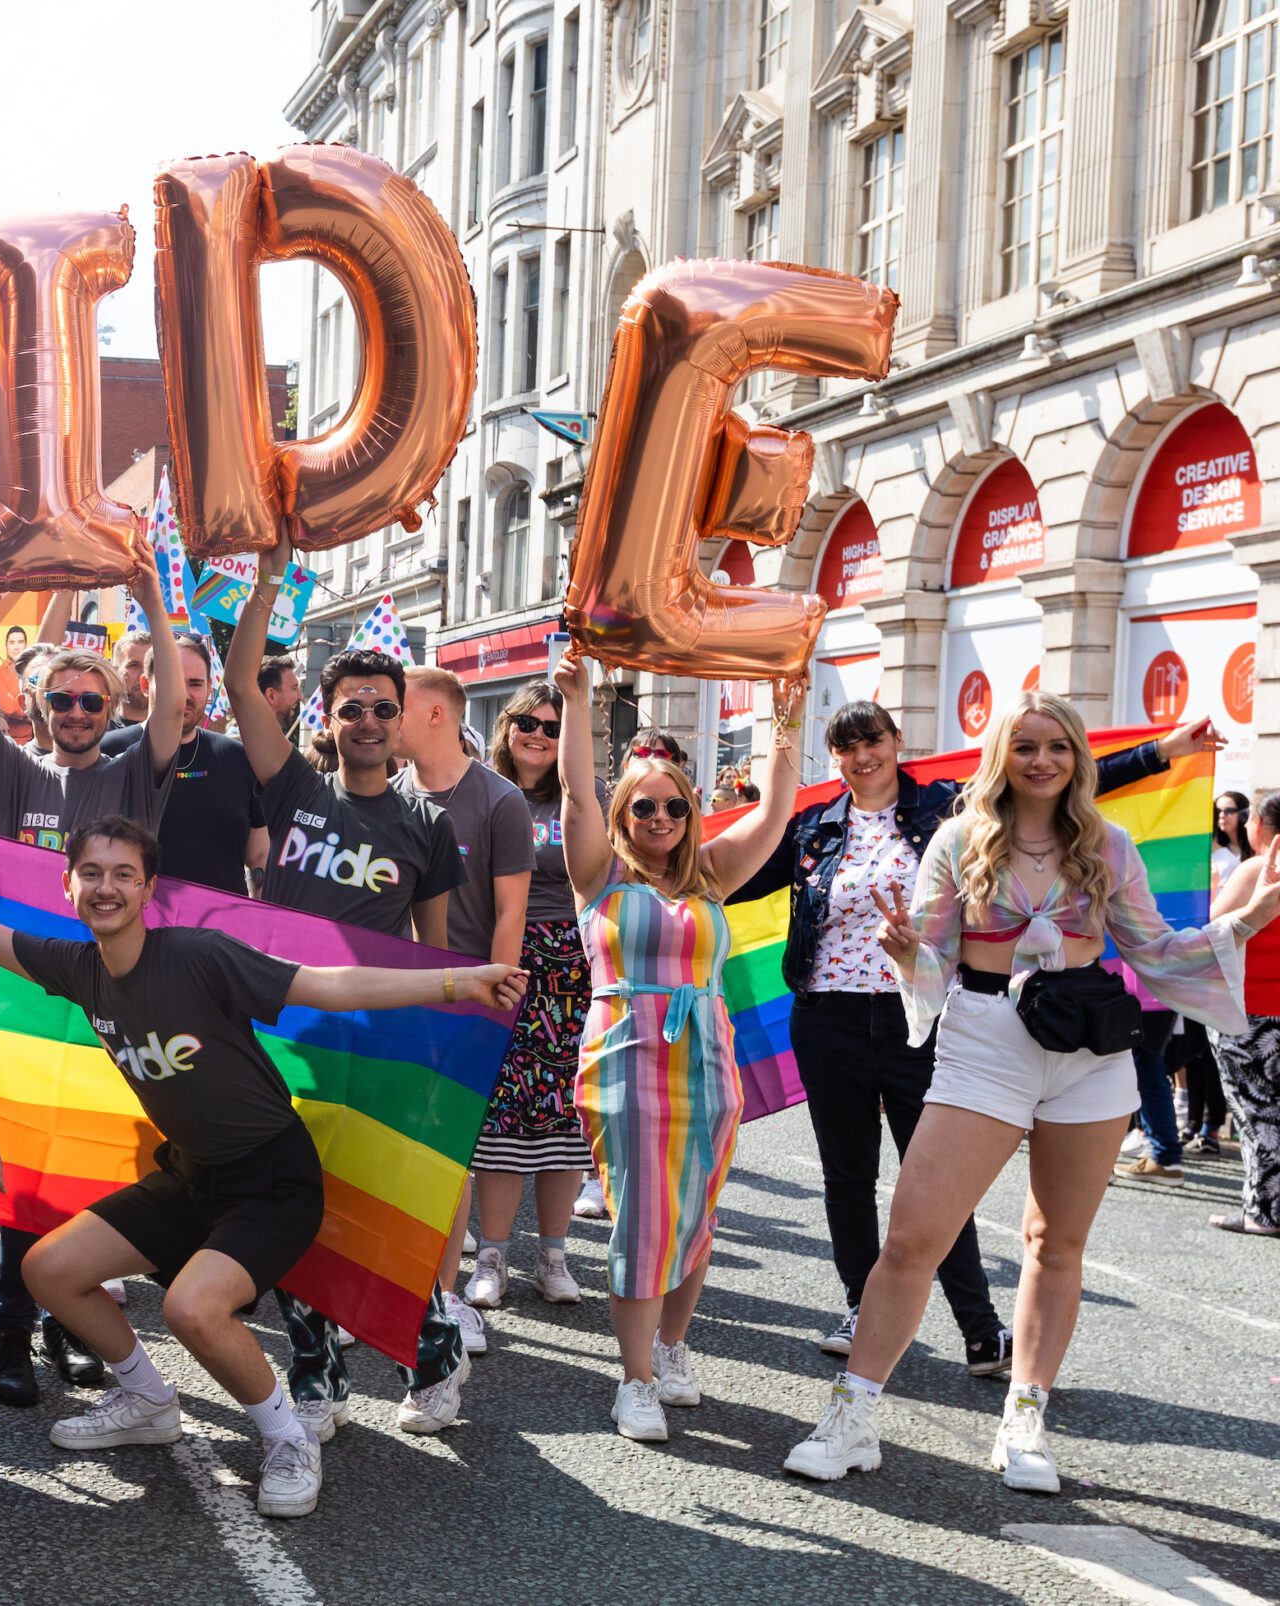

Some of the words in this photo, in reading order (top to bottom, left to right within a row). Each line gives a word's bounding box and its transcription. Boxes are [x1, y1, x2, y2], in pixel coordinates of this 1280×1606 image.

[1175, 451, 1250, 487] CREATIVE
[1182, 478, 1241, 508] DESIGN
[989, 501, 1037, 527] DISPLAY
[1177, 500, 1245, 533] SERVICE
[982, 520, 1043, 549] GRAPHICS
[980, 553, 988, 570] &
[991, 541, 1043, 568] SIGNAGE
[220, 583, 251, 610] DRE
[837, 582, 843, 597] &
[176, 770, 208, 779] TOGETHER
[23, 812, 60, 829] BBC
[293, 809, 326, 829] BBC
[278, 825, 400, 894] Pride
